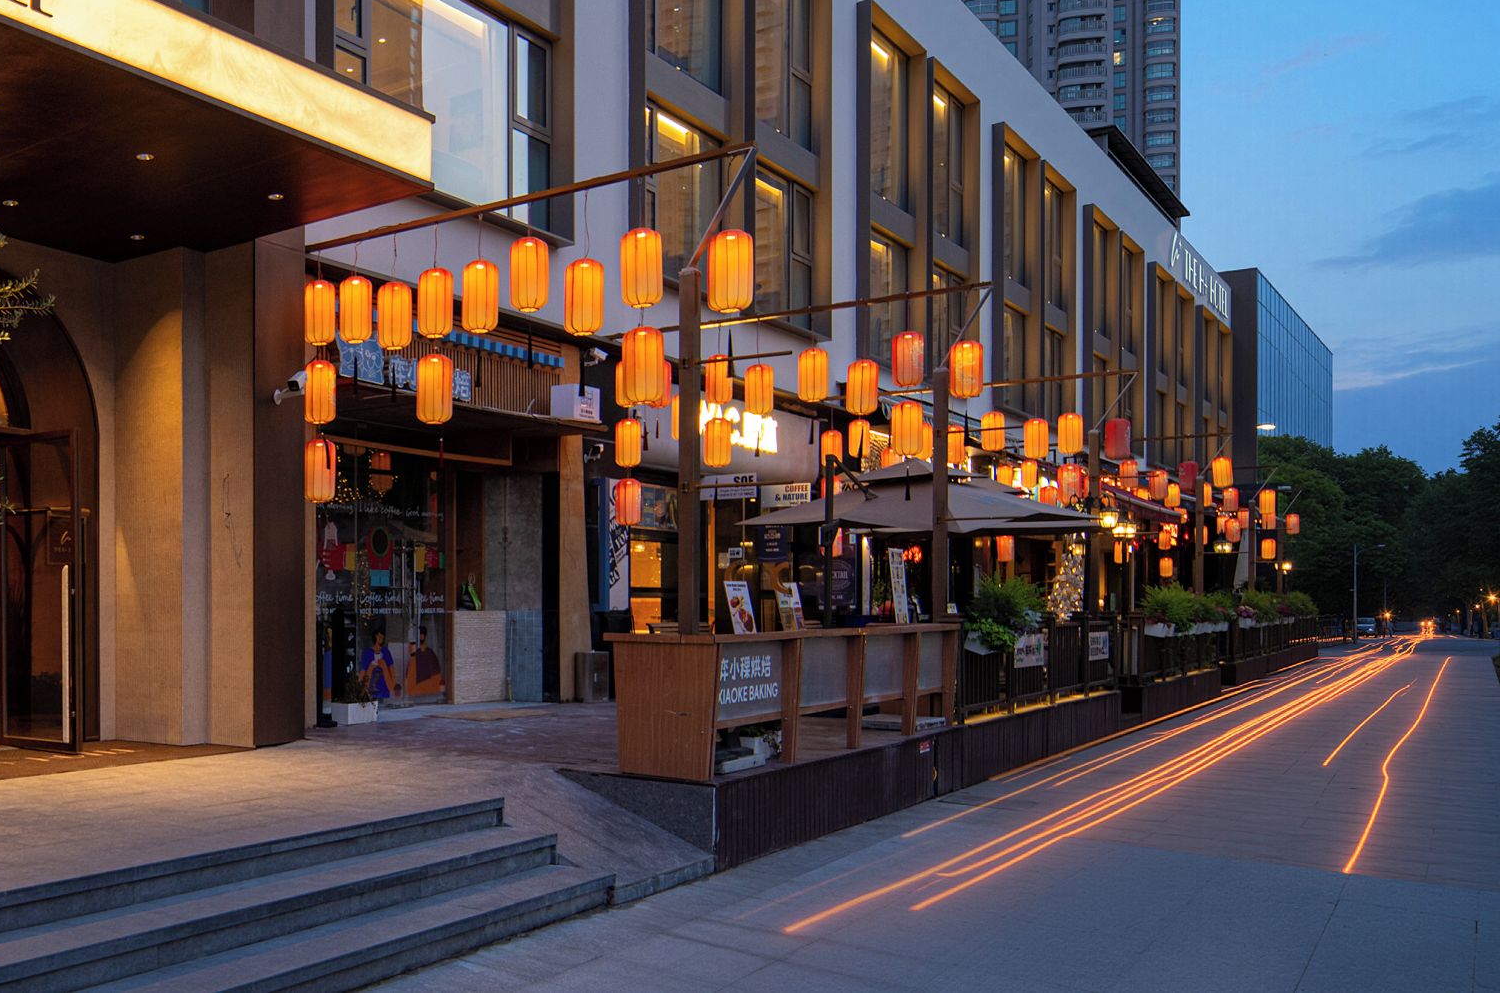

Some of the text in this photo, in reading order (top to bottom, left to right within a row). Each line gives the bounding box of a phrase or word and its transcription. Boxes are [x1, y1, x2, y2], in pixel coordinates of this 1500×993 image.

[1184, 248, 1198, 290] THE
[1209, 275, 1229, 319] HOTEL
[784, 484, 809, 492] COFFEE
[774, 492, 808, 502] & NATURE
[335, 591, 353, 605] time
[749, 682, 778, 701] BAKING
